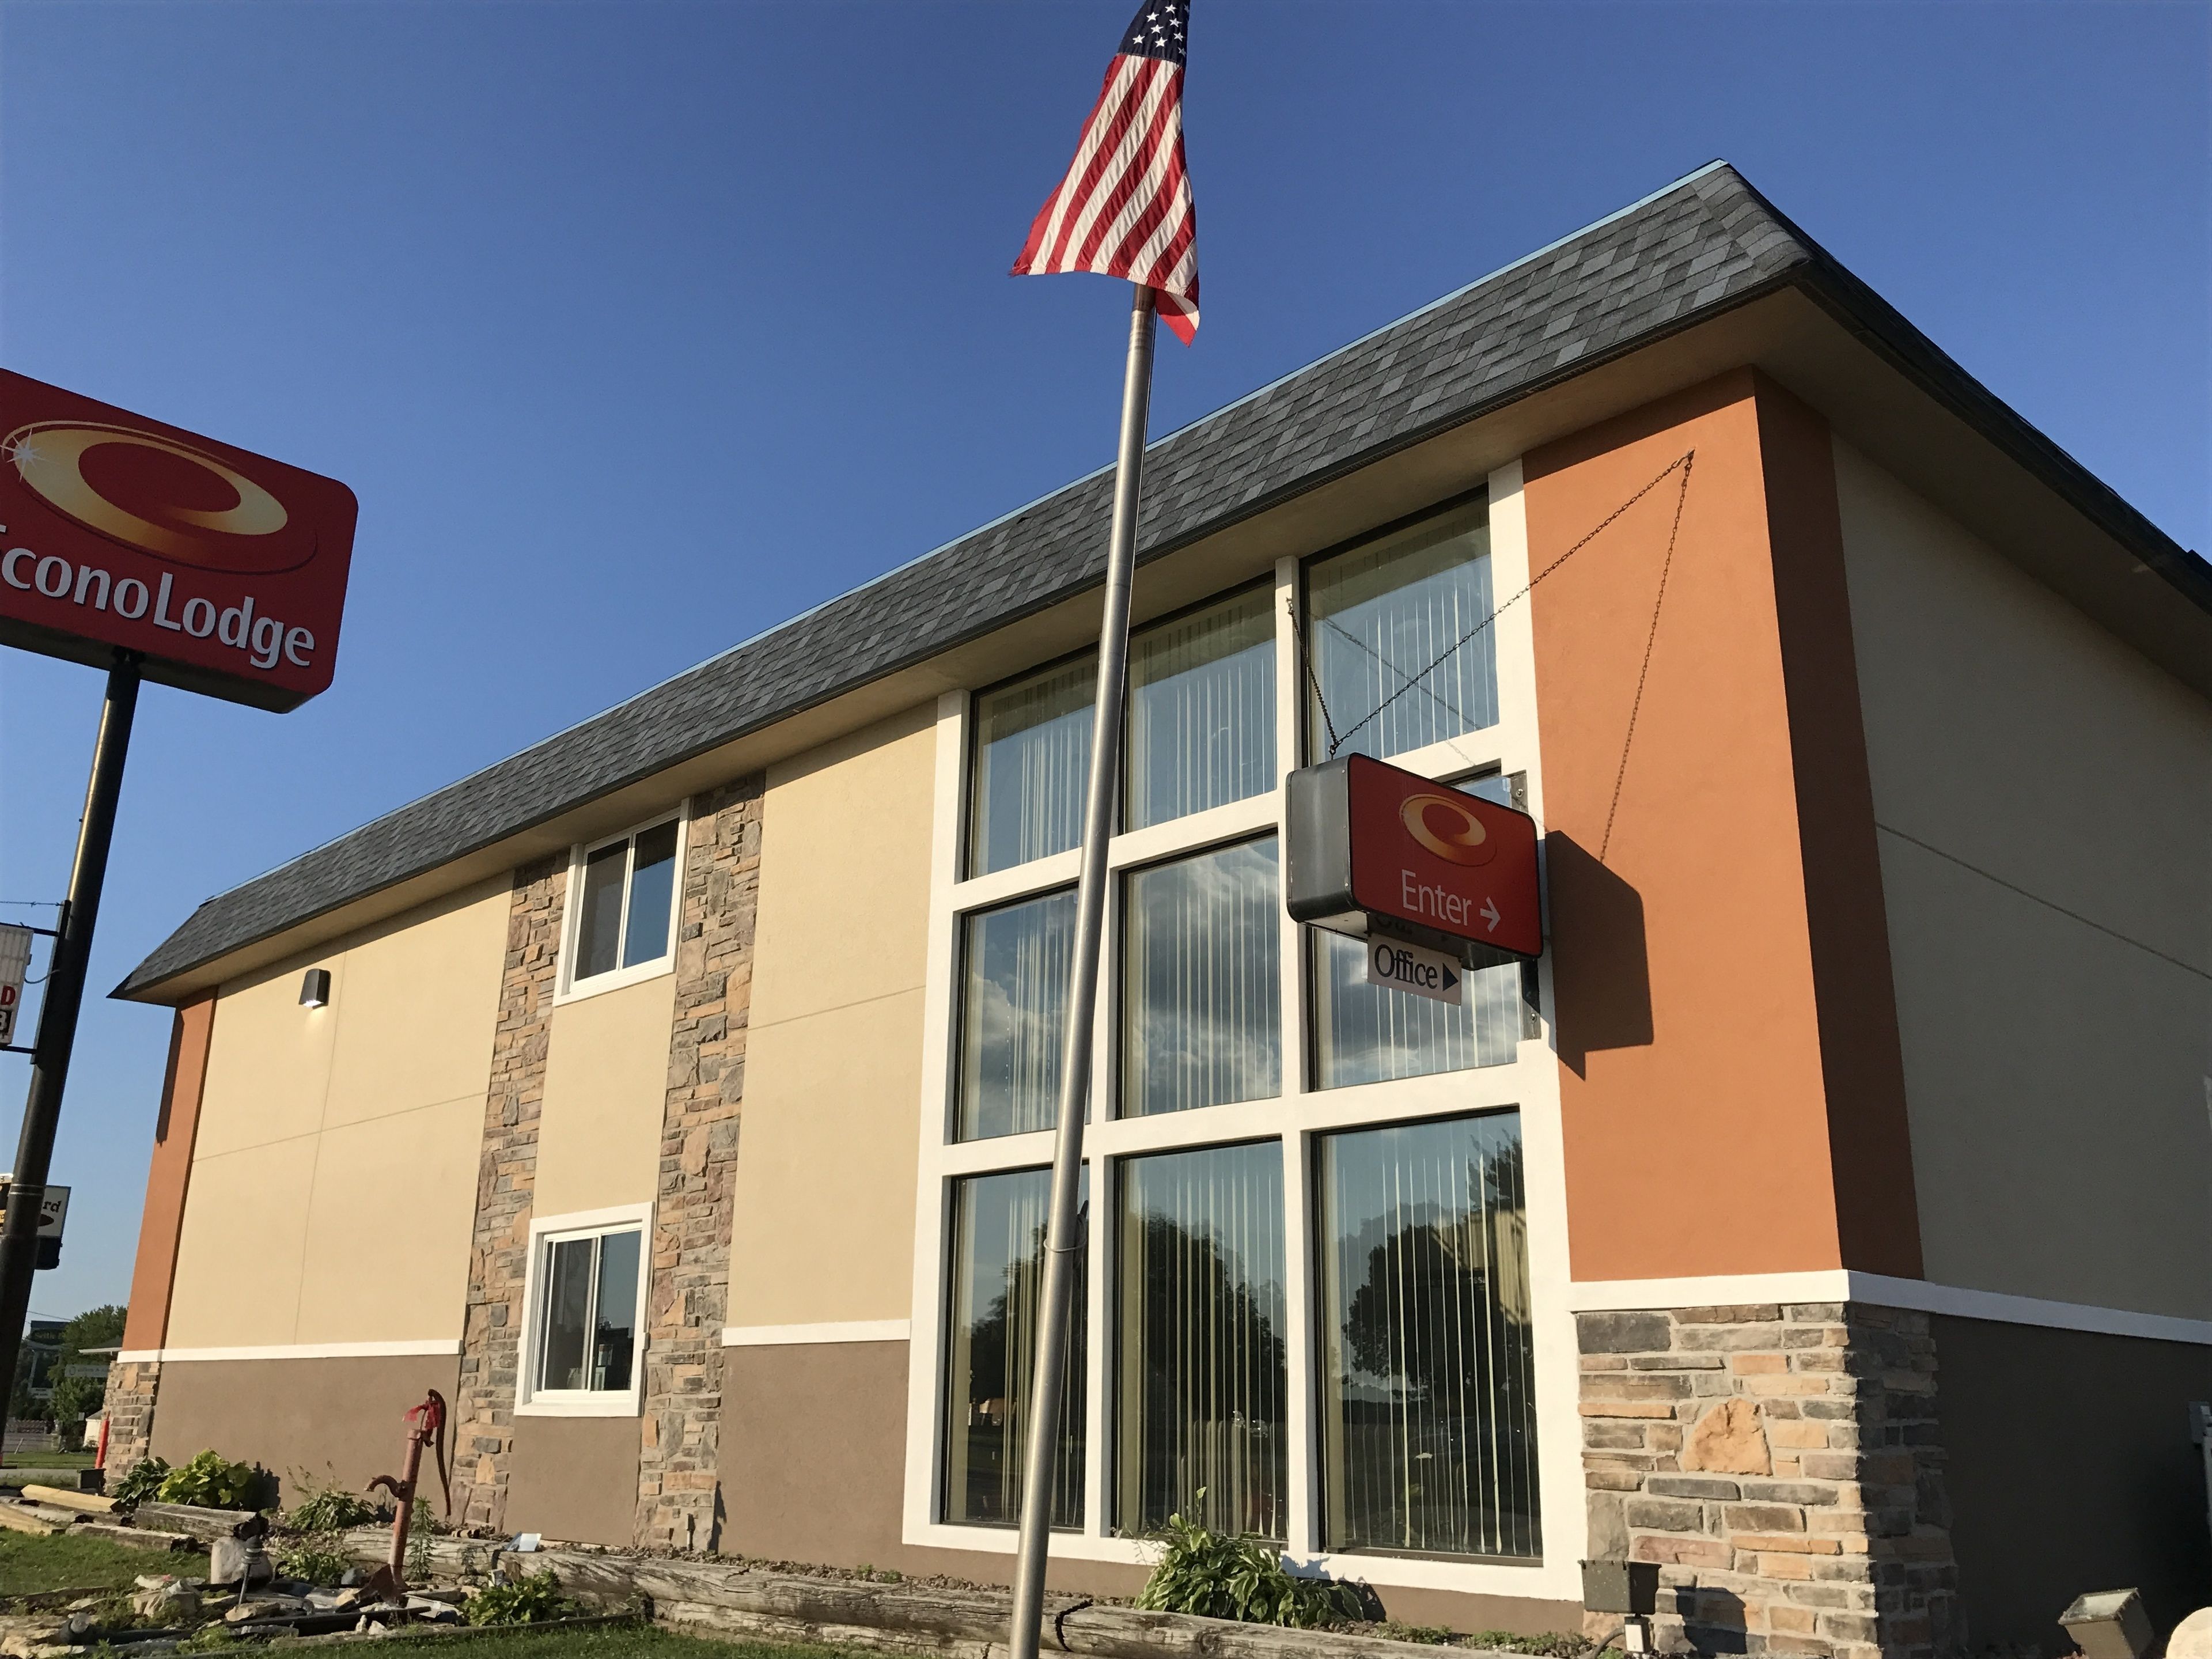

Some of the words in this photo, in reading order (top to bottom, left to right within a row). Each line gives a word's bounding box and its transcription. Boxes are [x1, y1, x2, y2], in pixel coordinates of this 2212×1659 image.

[0, 524, 315, 669] conoLodge
[1401, 869, 1473, 926] Enter
[1374, 944, 1438, 990] Office
